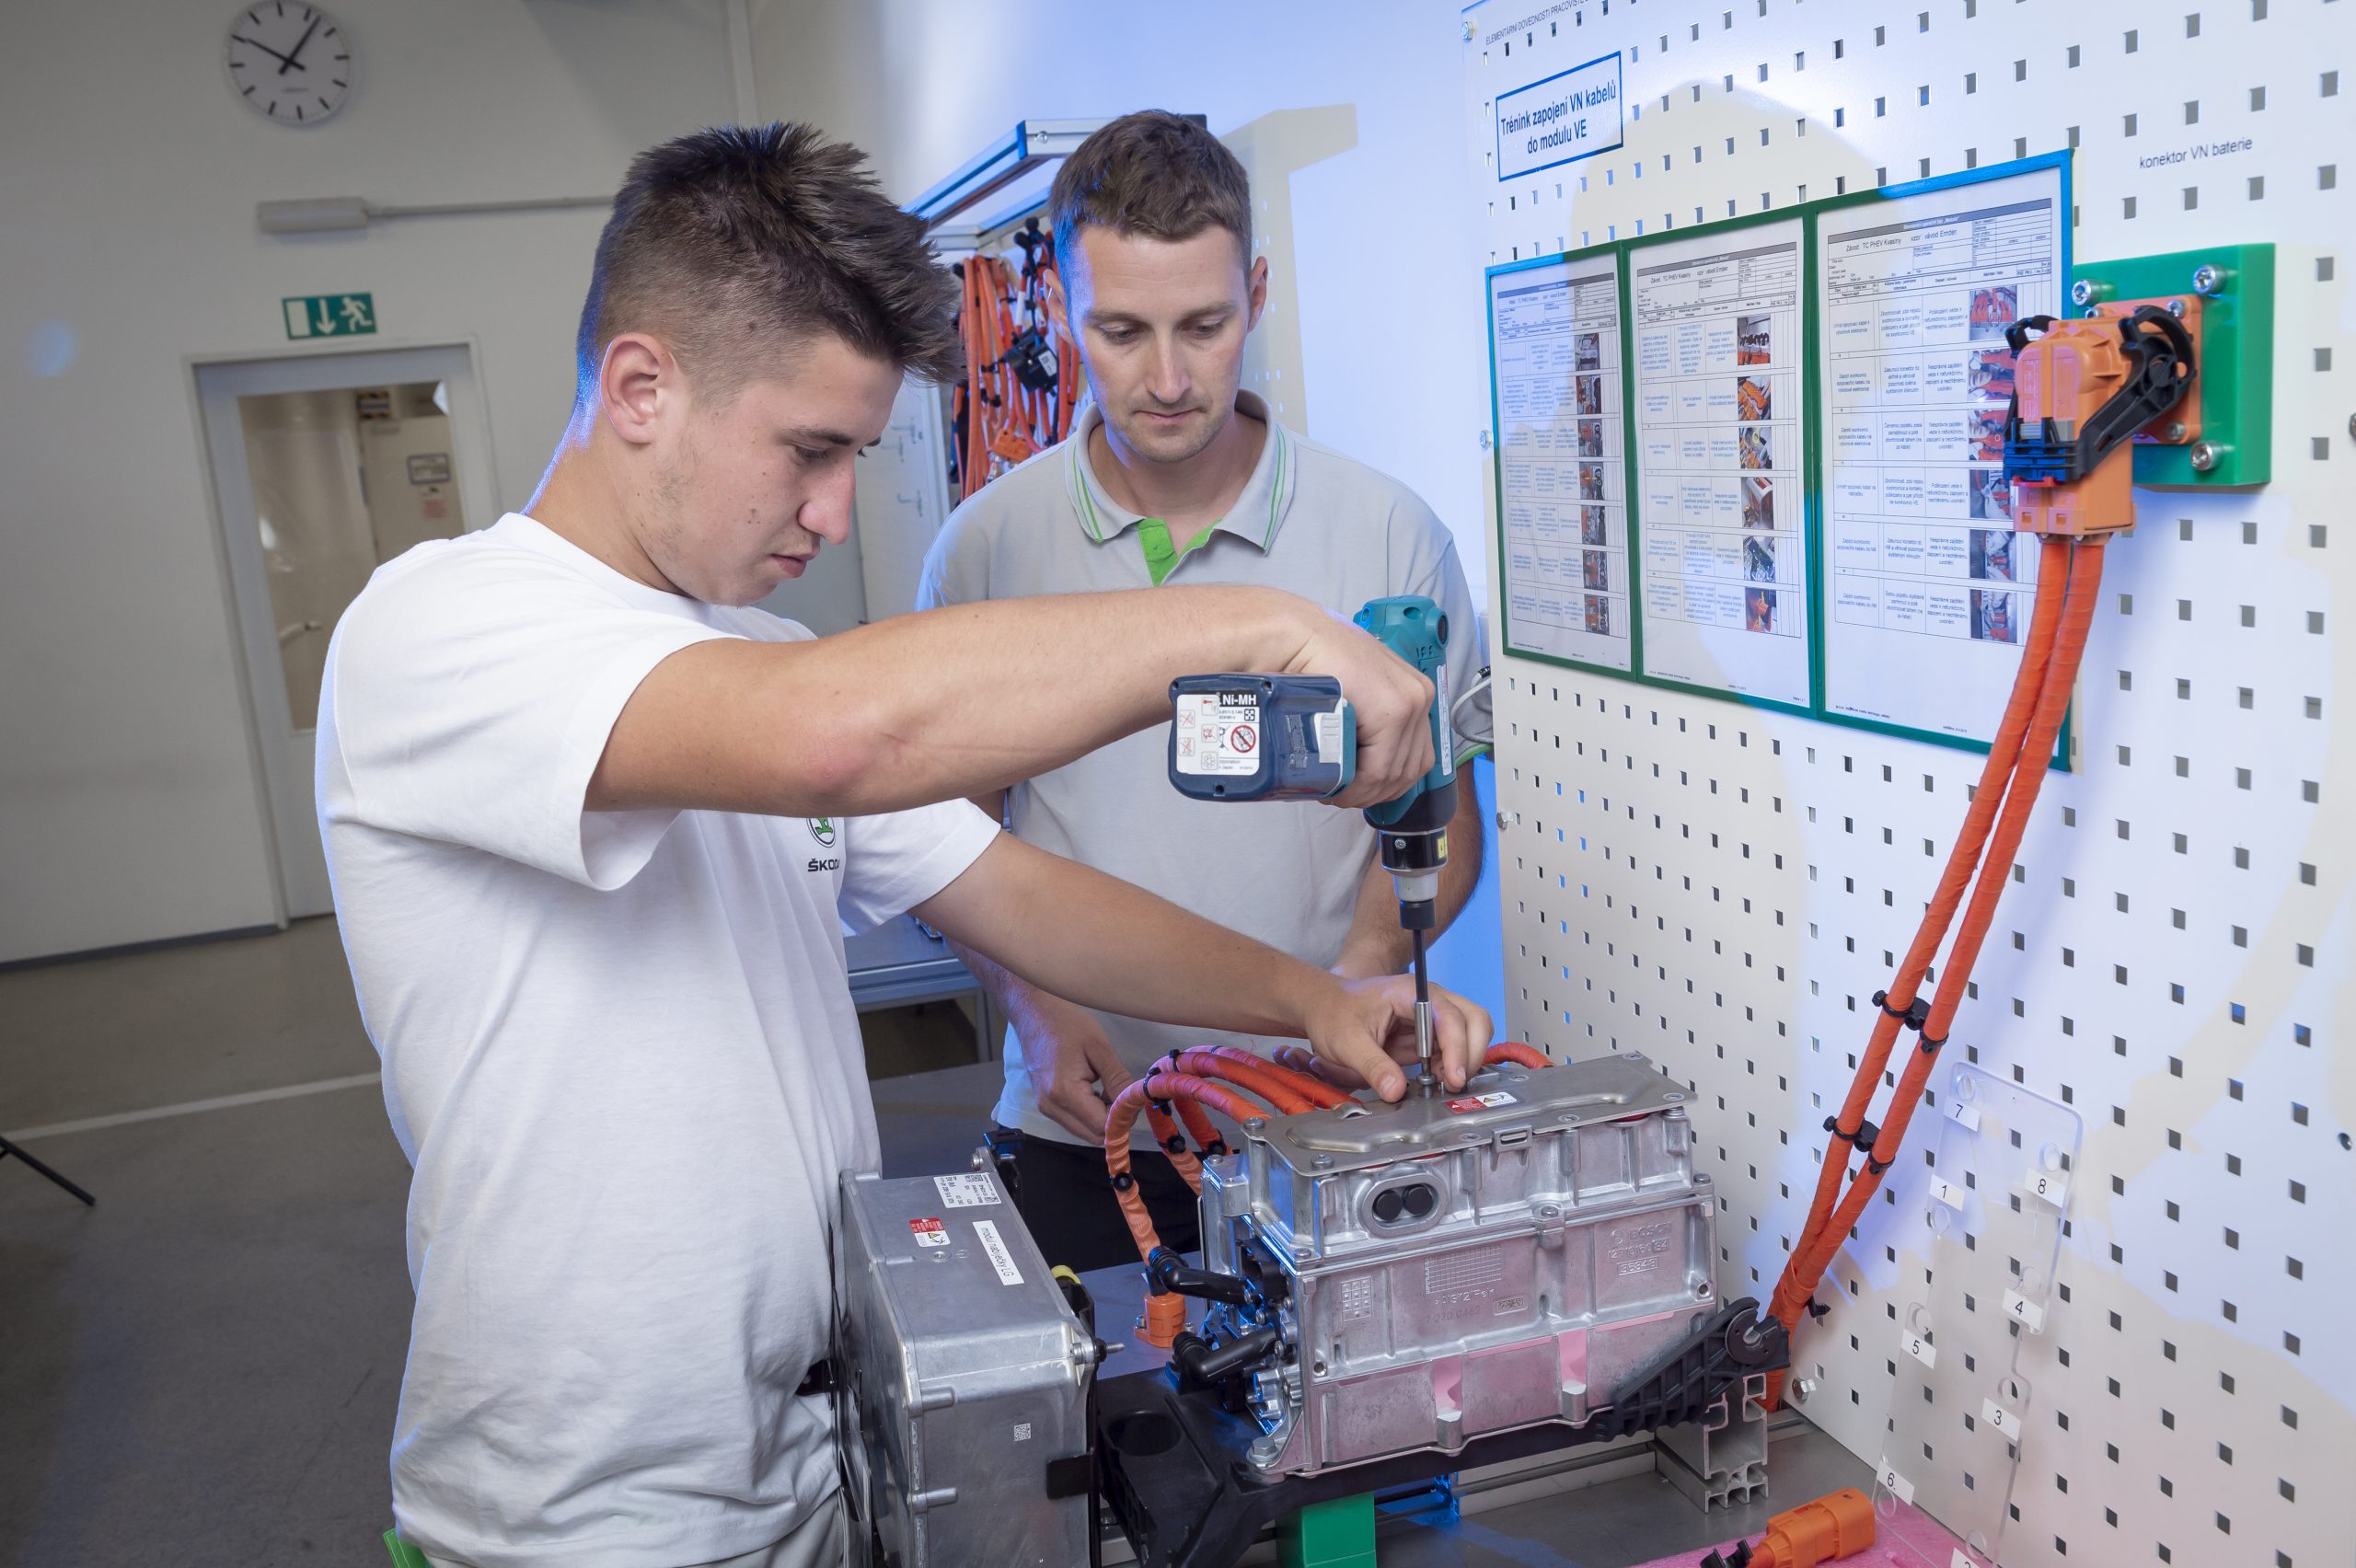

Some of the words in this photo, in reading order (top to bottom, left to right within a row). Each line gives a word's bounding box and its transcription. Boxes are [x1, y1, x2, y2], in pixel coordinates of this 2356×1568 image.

[1519, 8, 1551, 30] DOVEDNOSTI
[1501, 110, 1530, 135] Trénink
[1532, 96, 1568, 127] zapojení
[1570, 91, 1583, 112] VN
[1586, 79, 1616, 108] kabelů
[1528, 136, 1538, 154] do
[1541, 125, 1572, 150] modulu
[1574, 119, 1587, 139] VE
[2140, 151, 2188, 169] konektor
[2190, 144, 2209, 159] VN
[2212, 137, 2253, 156] baterie
[1223, 695, 1256, 706] Ni-MH
[1955, 1103, 1963, 1118] 7
[1942, 1184, 1947, 1198] 1
[2038, 1178, 2046, 1194] 8
[1001, 1267, 1014, 1276] LG
[2015, 1300, 2023, 1316] 4
[1912, 1340, 1920, 1355] 5
[1993, 1410, 2003, 1425] 3
